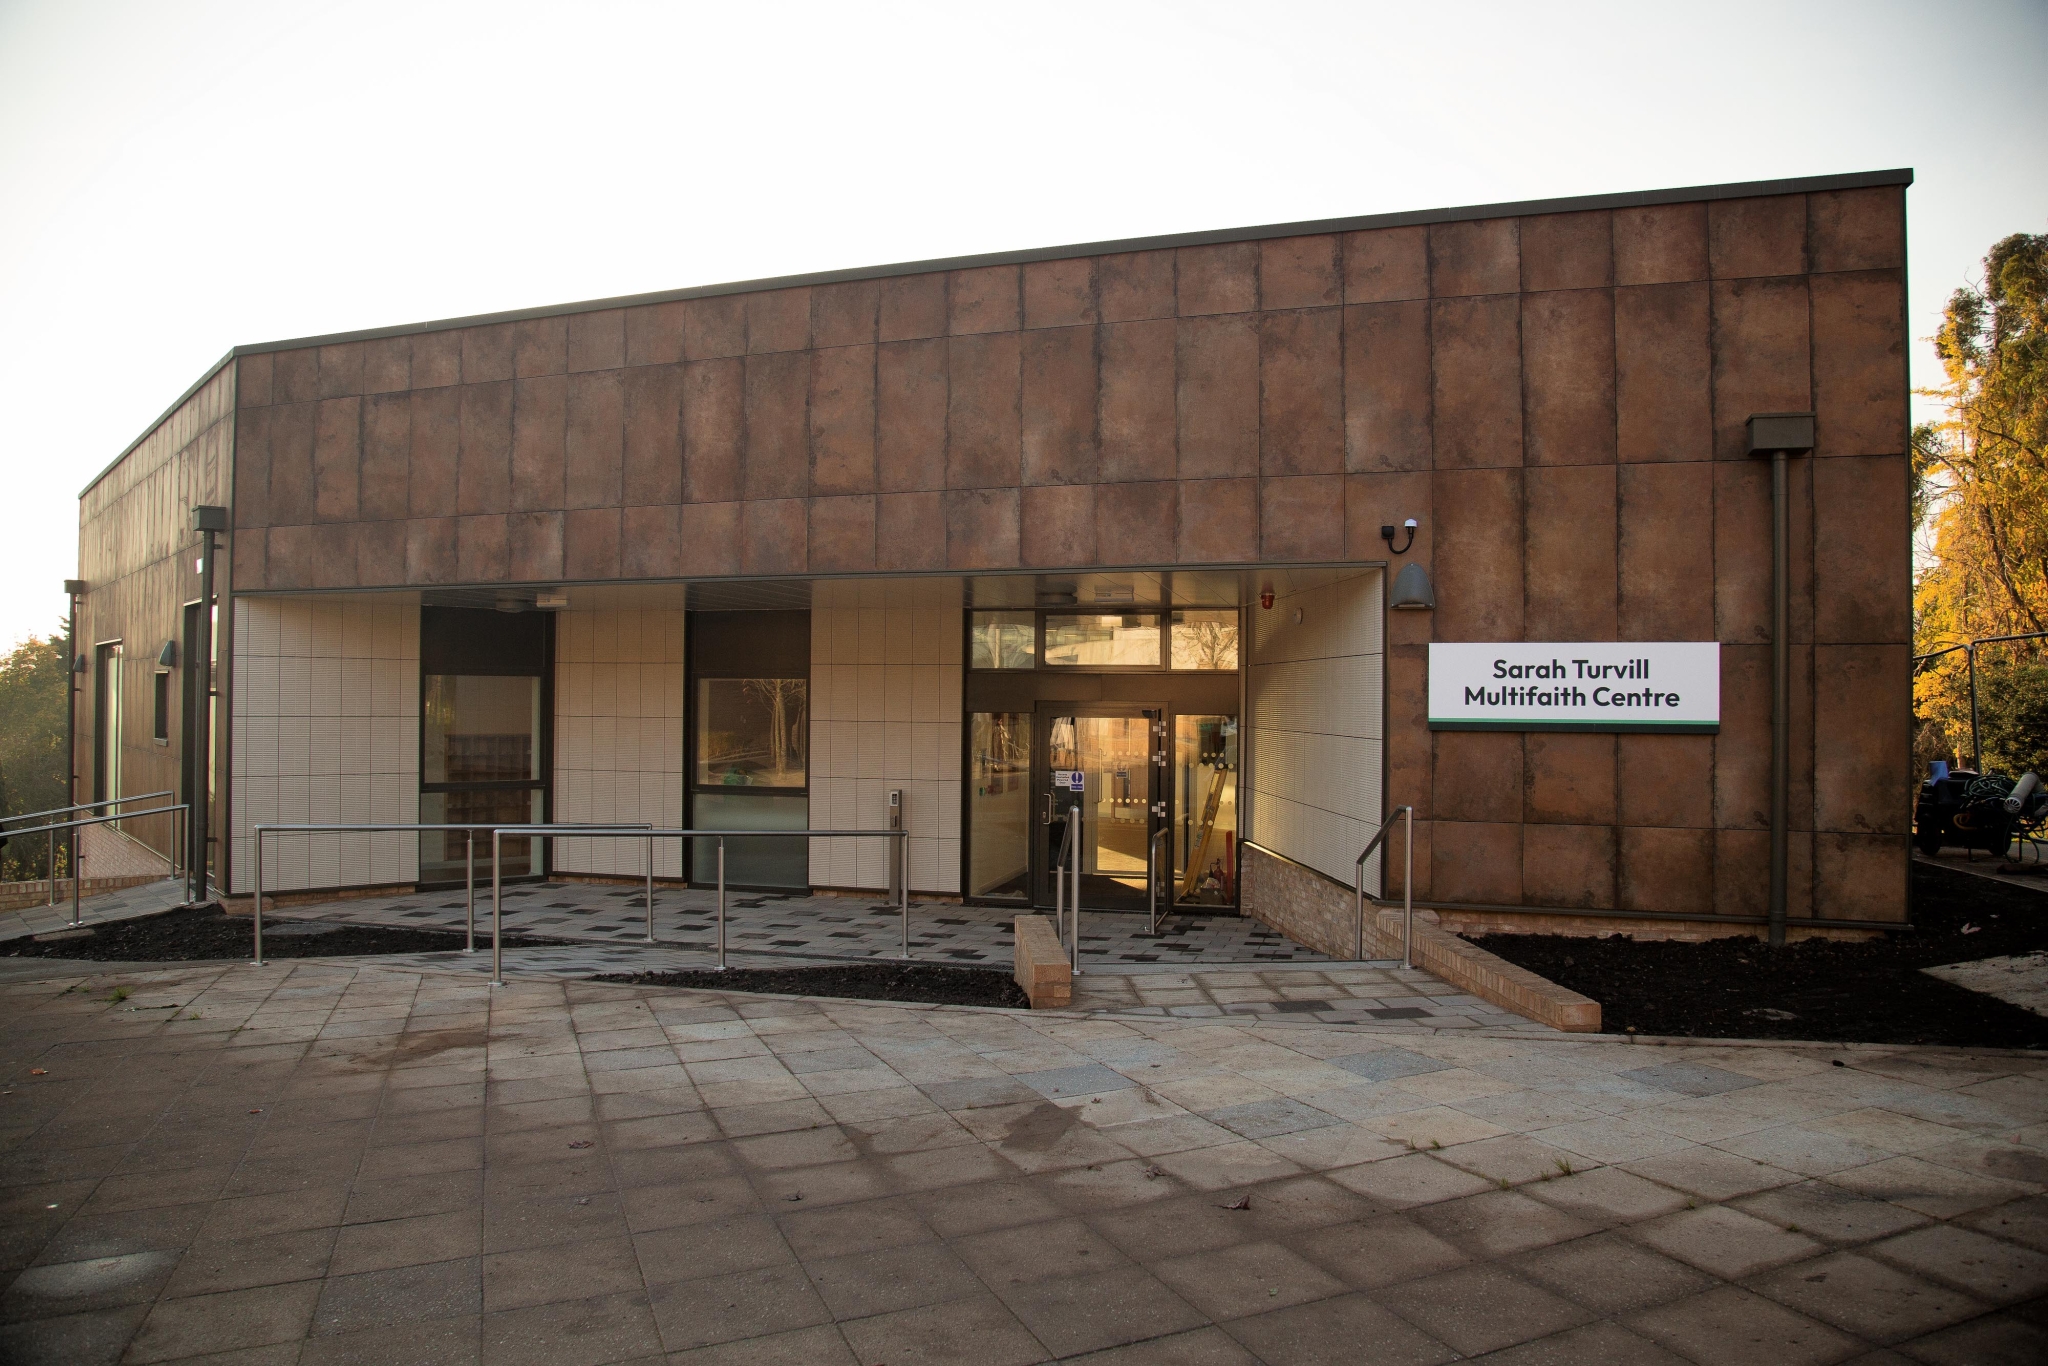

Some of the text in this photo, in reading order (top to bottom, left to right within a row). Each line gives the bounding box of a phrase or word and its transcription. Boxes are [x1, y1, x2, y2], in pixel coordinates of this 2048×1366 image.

[1492, 659, 1649, 679] Sarah Turvill
[1464, 686, 1680, 707] Multifaith Centre
